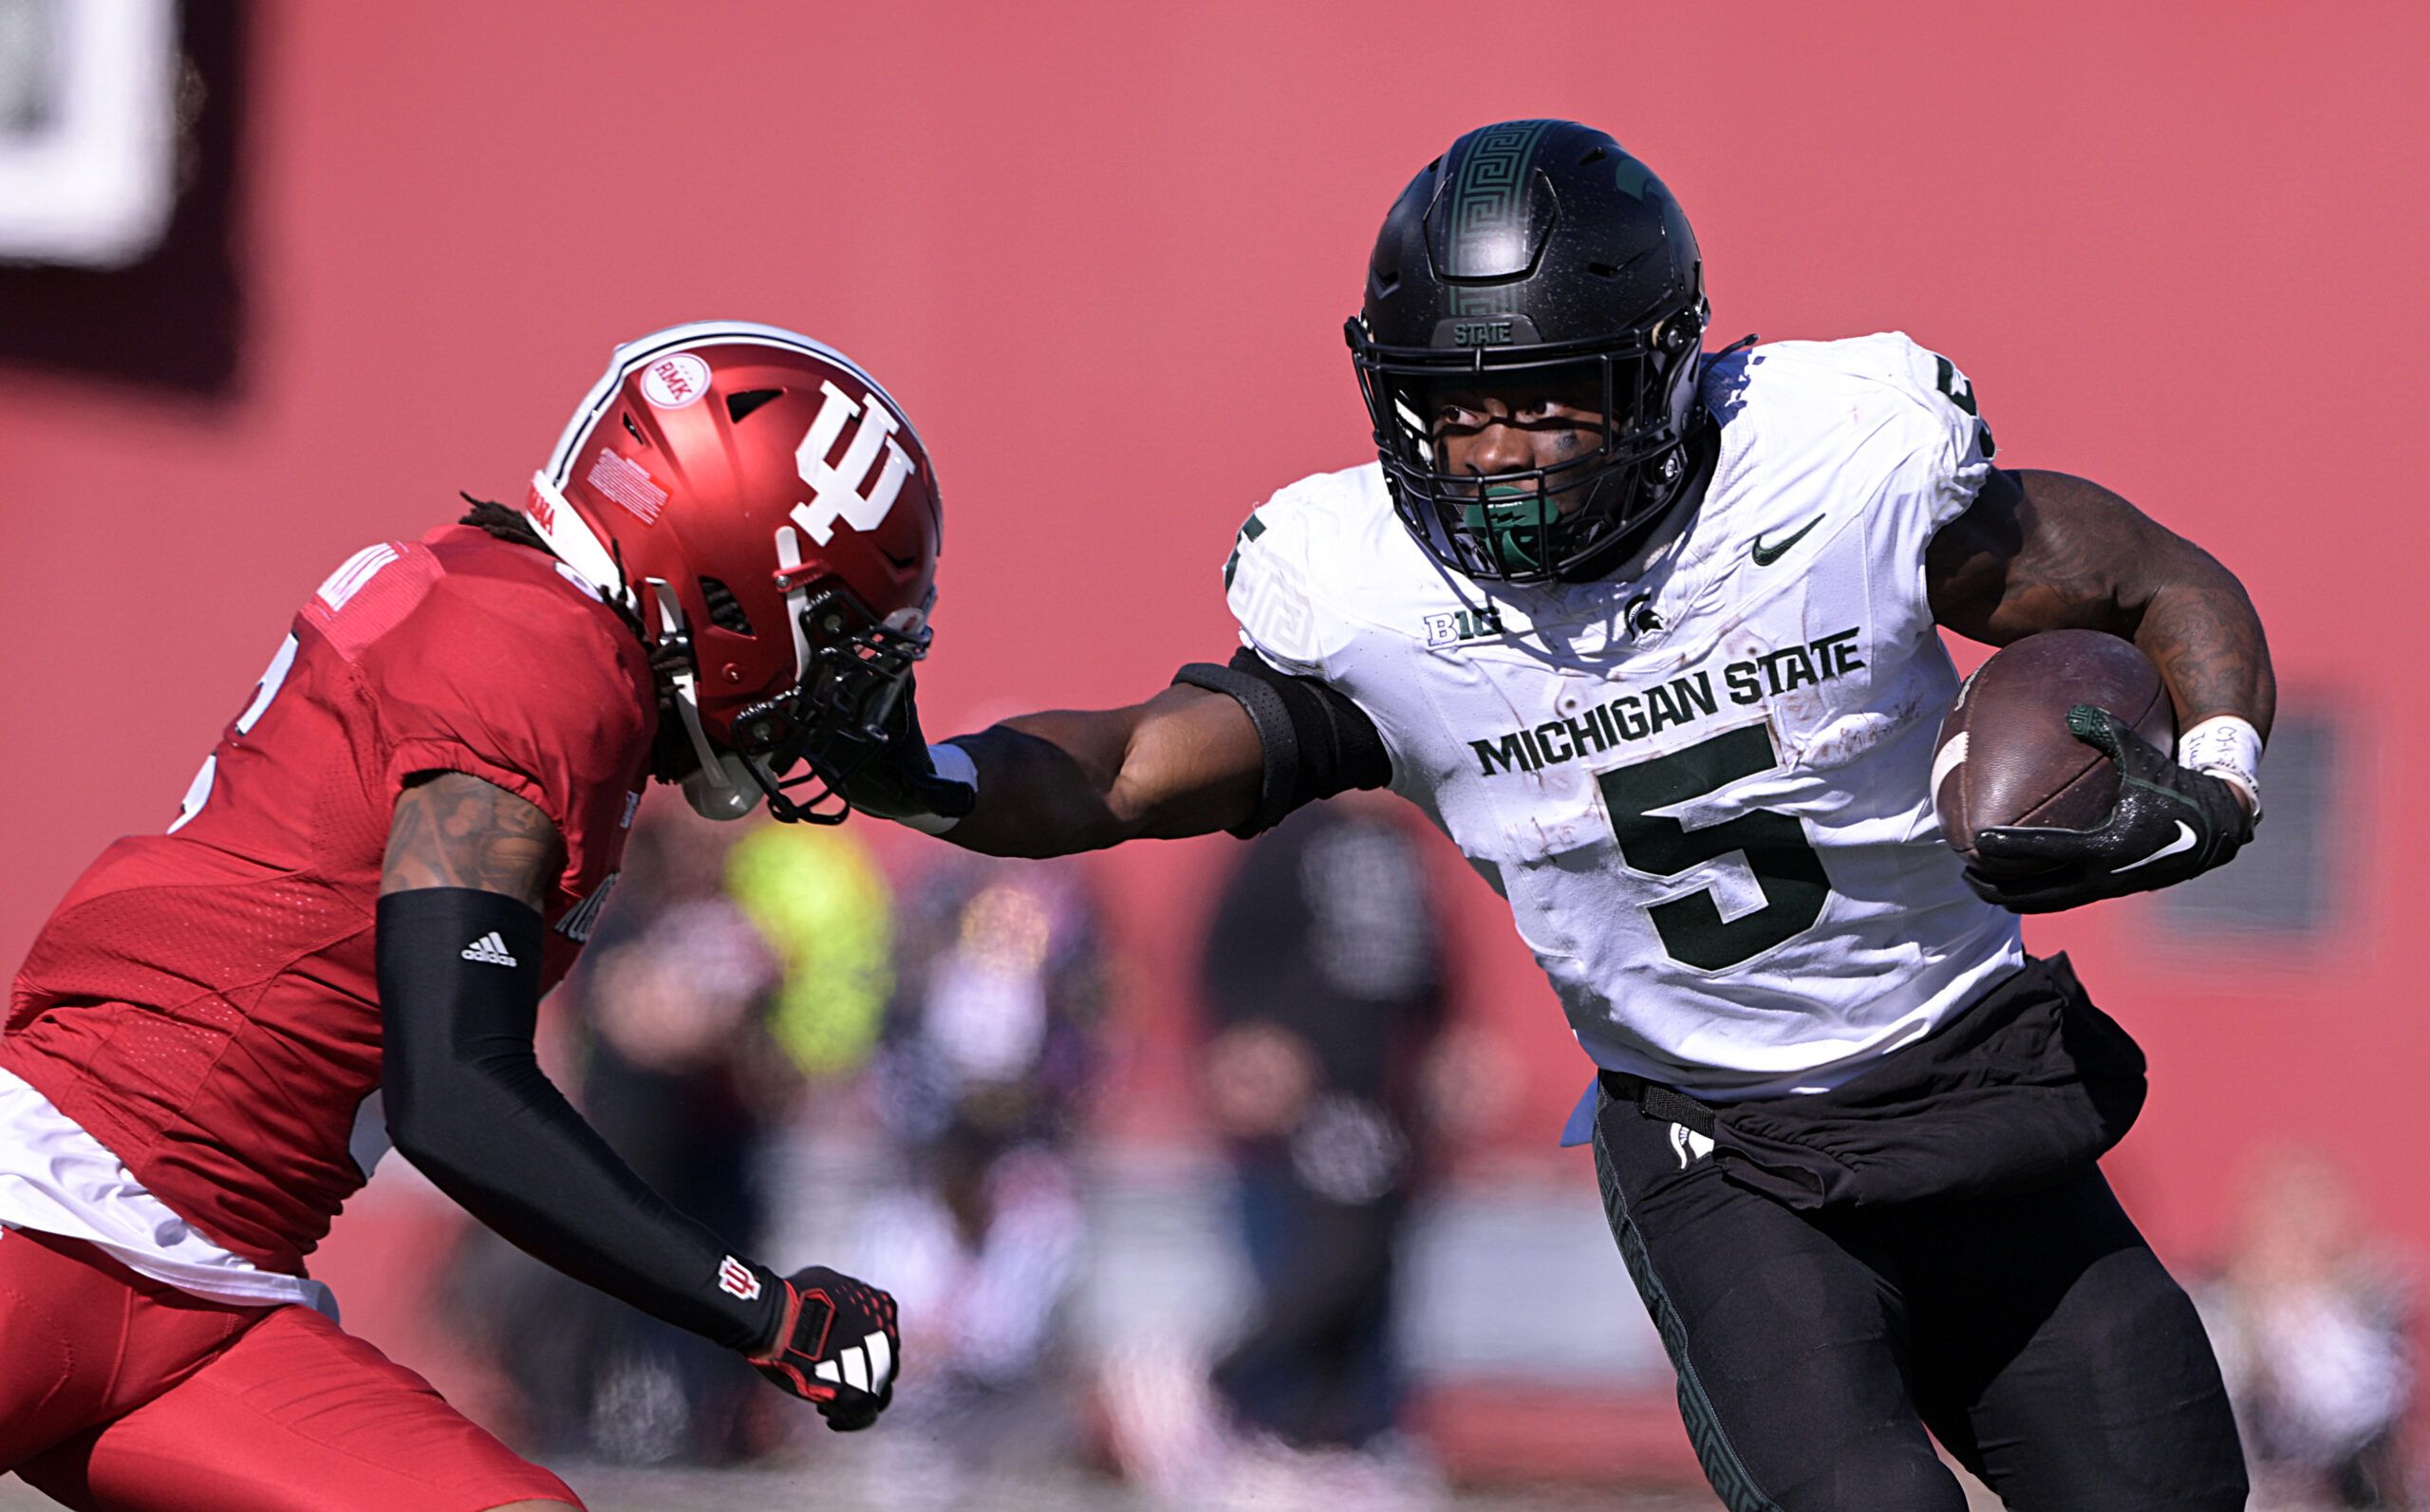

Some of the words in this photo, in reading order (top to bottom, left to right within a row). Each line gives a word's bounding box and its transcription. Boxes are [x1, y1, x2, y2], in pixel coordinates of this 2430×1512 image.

[1454, 322, 1513, 345] STATE
[655, 361, 693, 401] RMK
[1467, 670, 1718, 776] MICHIGAN
[1724, 626, 1866, 705] STATE
[1595, 719, 1833, 974] 5
[460, 949, 517, 968] adidas
